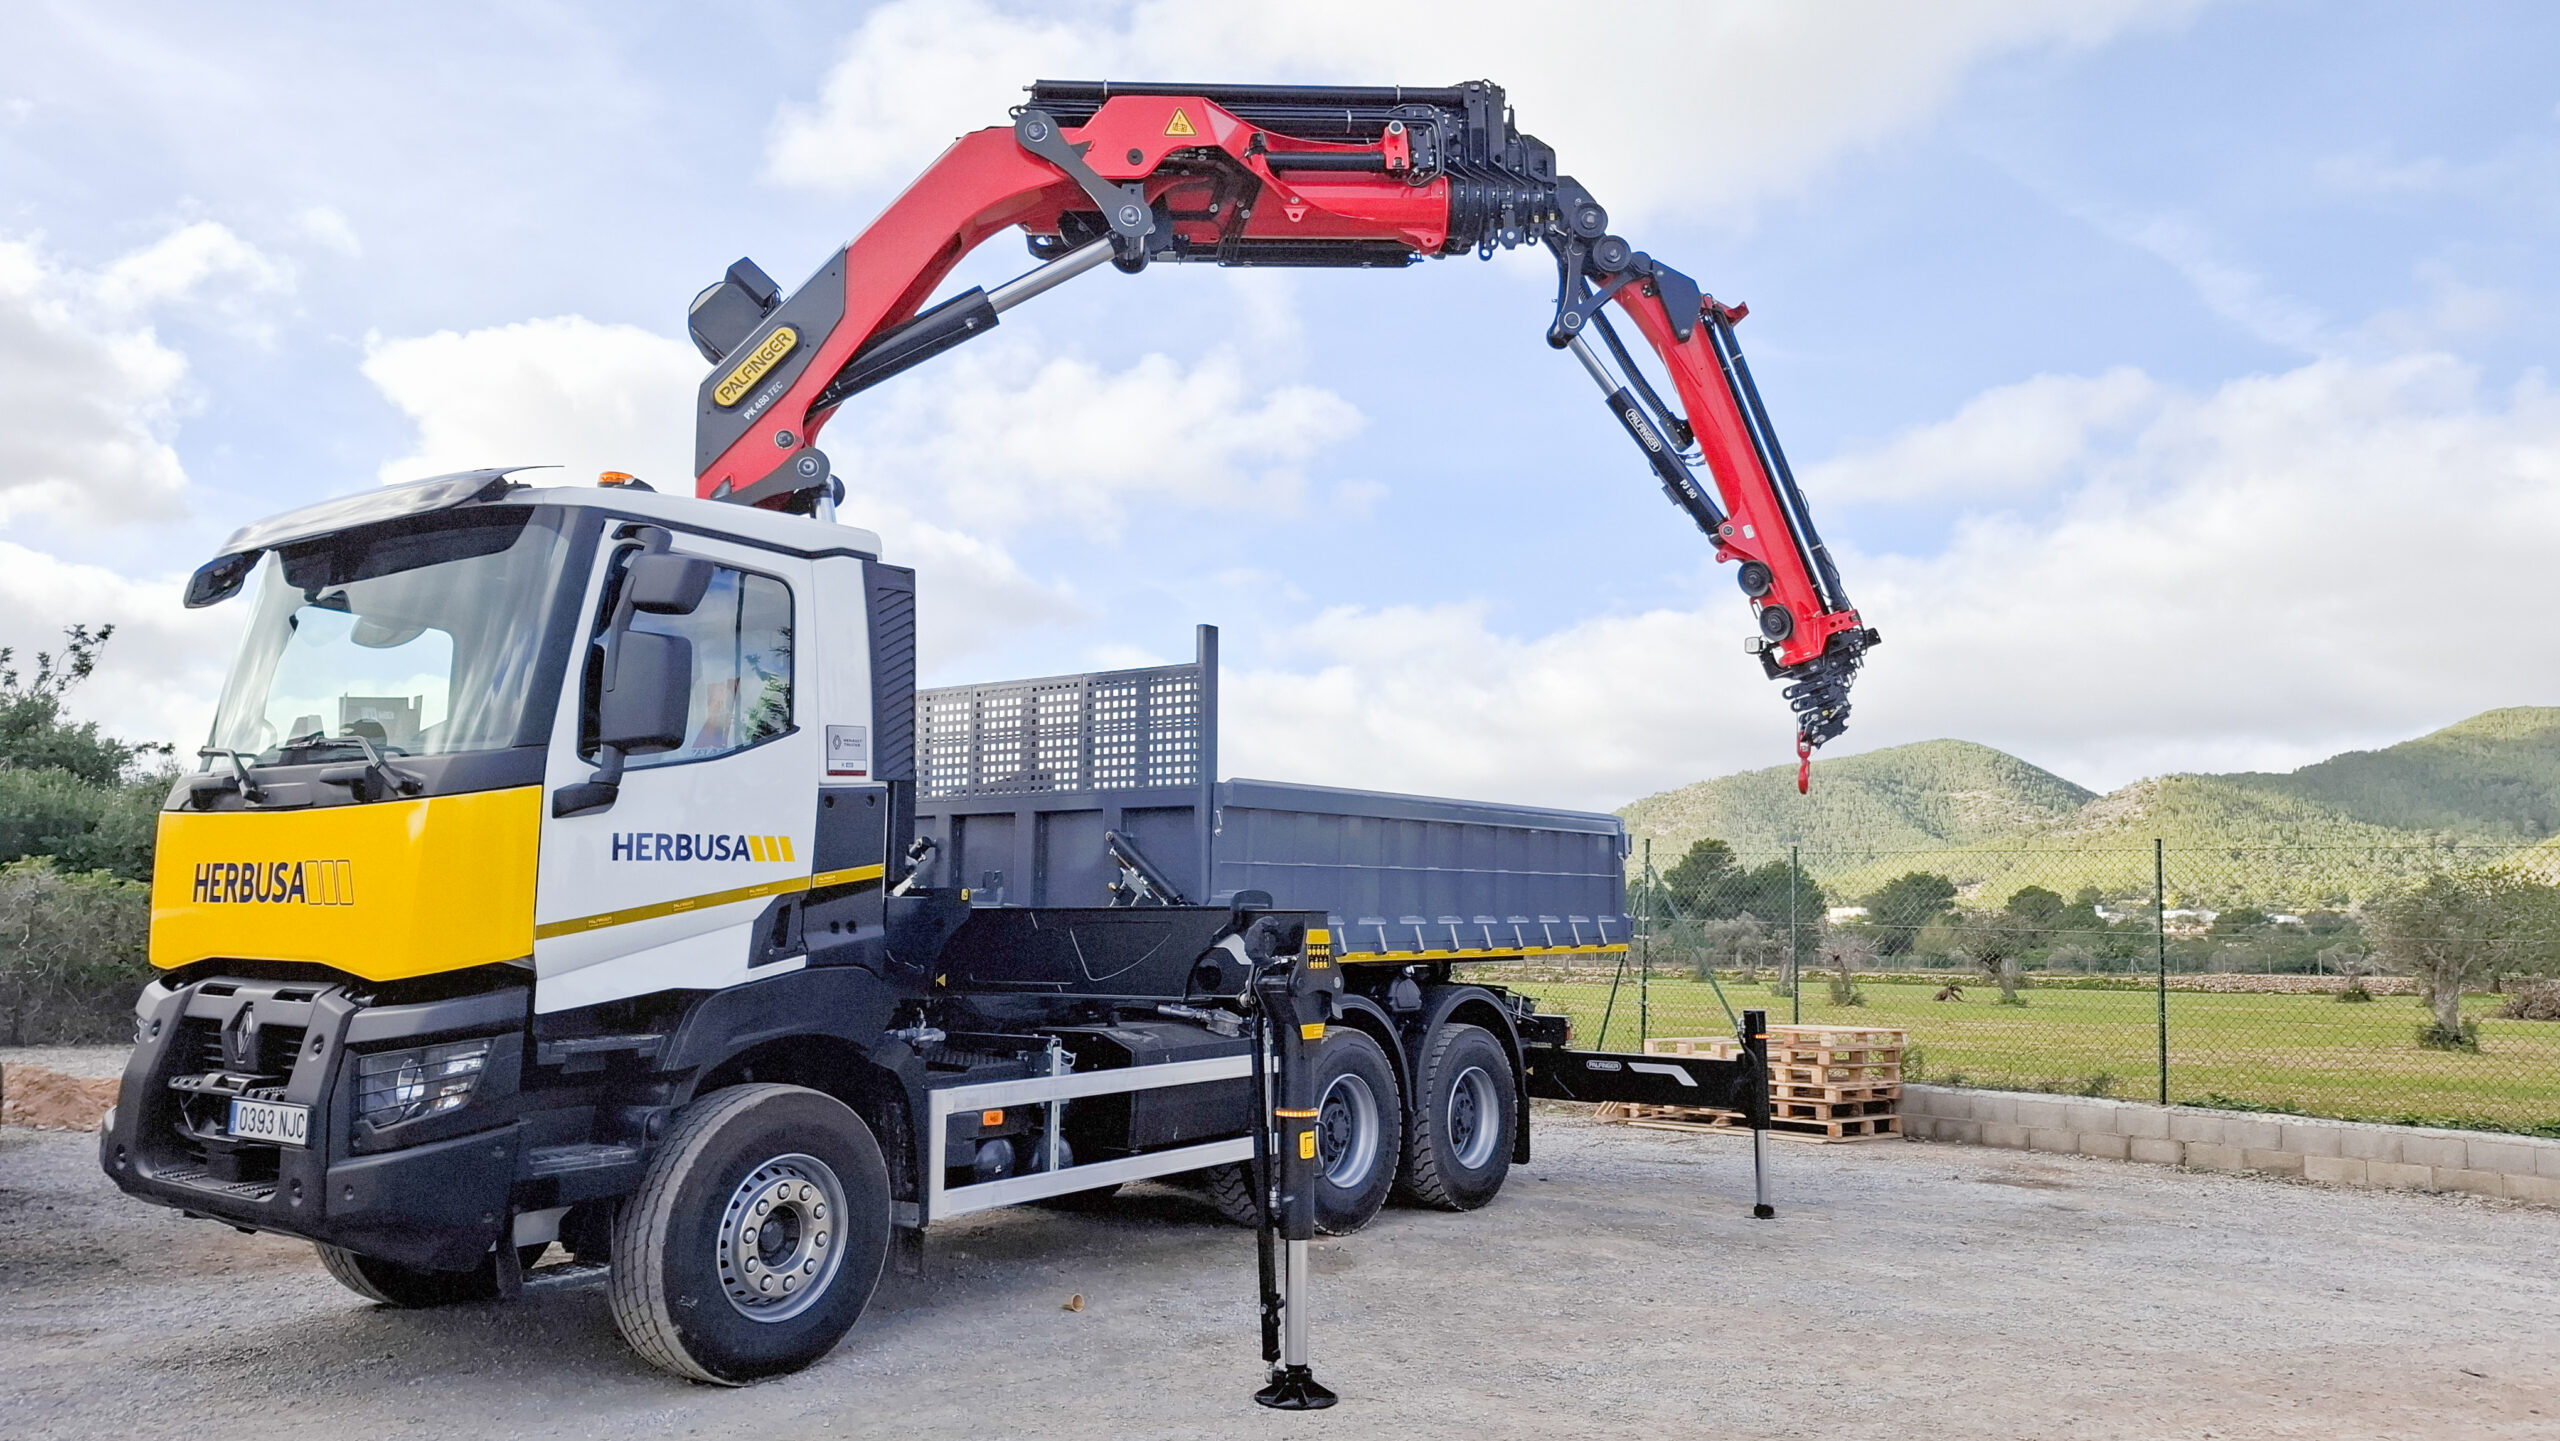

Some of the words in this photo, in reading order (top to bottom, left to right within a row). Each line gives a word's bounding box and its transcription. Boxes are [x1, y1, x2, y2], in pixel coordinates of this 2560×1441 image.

[719, 332, 792, 401] PALFINGER
[743, 406, 757, 420] PK
[755, 394, 770, 410] 480
[767, 381, 783, 396] TEC
[1628, 411, 1659, 450] PALFINGER
[1679, 479, 1691, 490] PJ
[1686, 487, 1698, 499] 90
[612, 832, 751, 862] HERBUSA
[192, 861, 306, 904] HERBUSA
[239, 1106, 275, 1135] 0393
[279, 1110, 305, 1139] NJC
